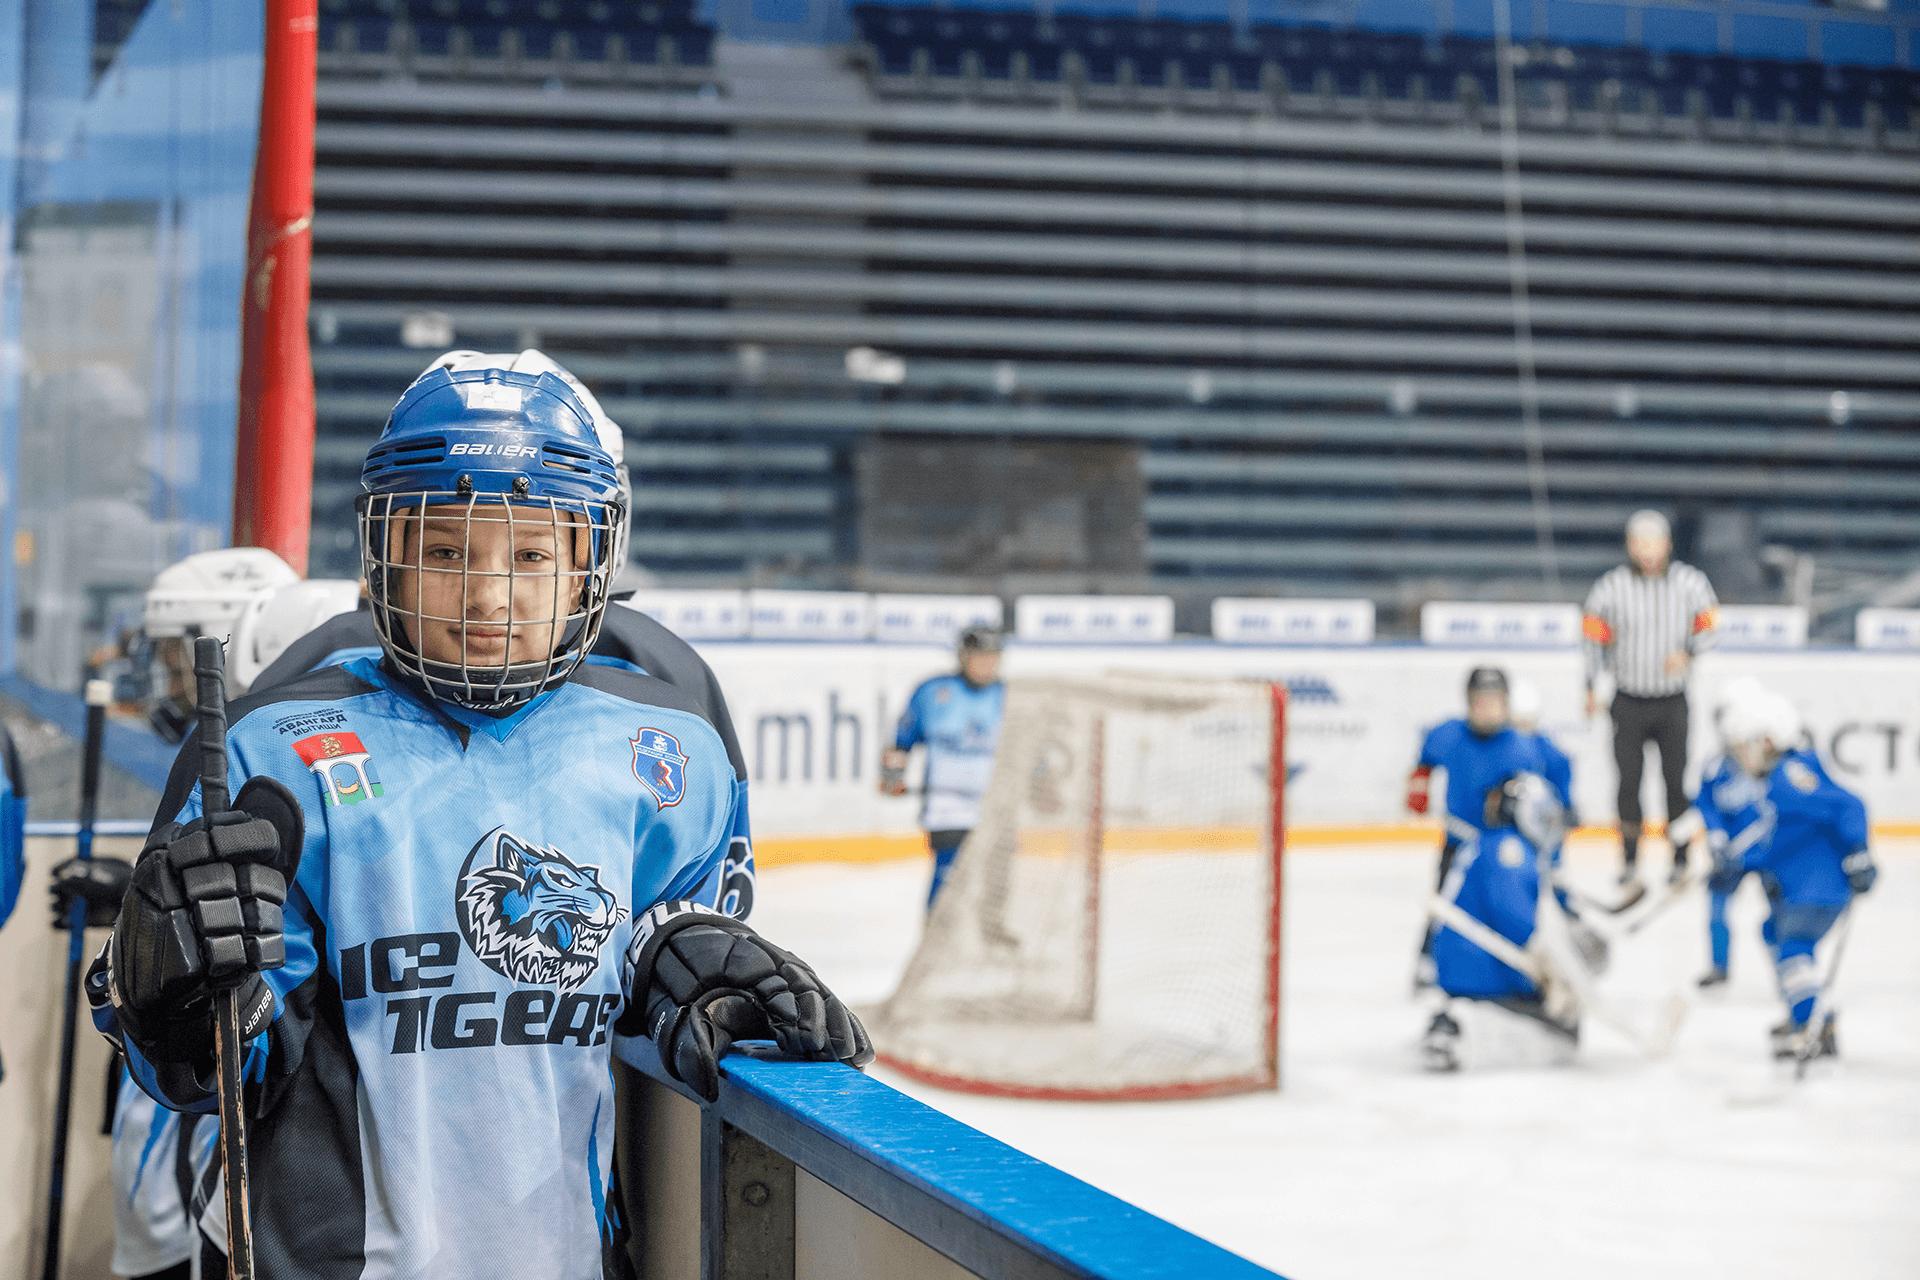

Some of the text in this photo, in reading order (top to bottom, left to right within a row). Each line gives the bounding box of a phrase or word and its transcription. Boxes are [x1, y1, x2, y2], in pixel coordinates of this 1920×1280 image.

[449, 443, 539, 458] BAUER
[279, 713, 348, 735] АВАНГАРД
[340, 931, 461, 1001] ICE
[244, 988, 272, 1035] BAUER
